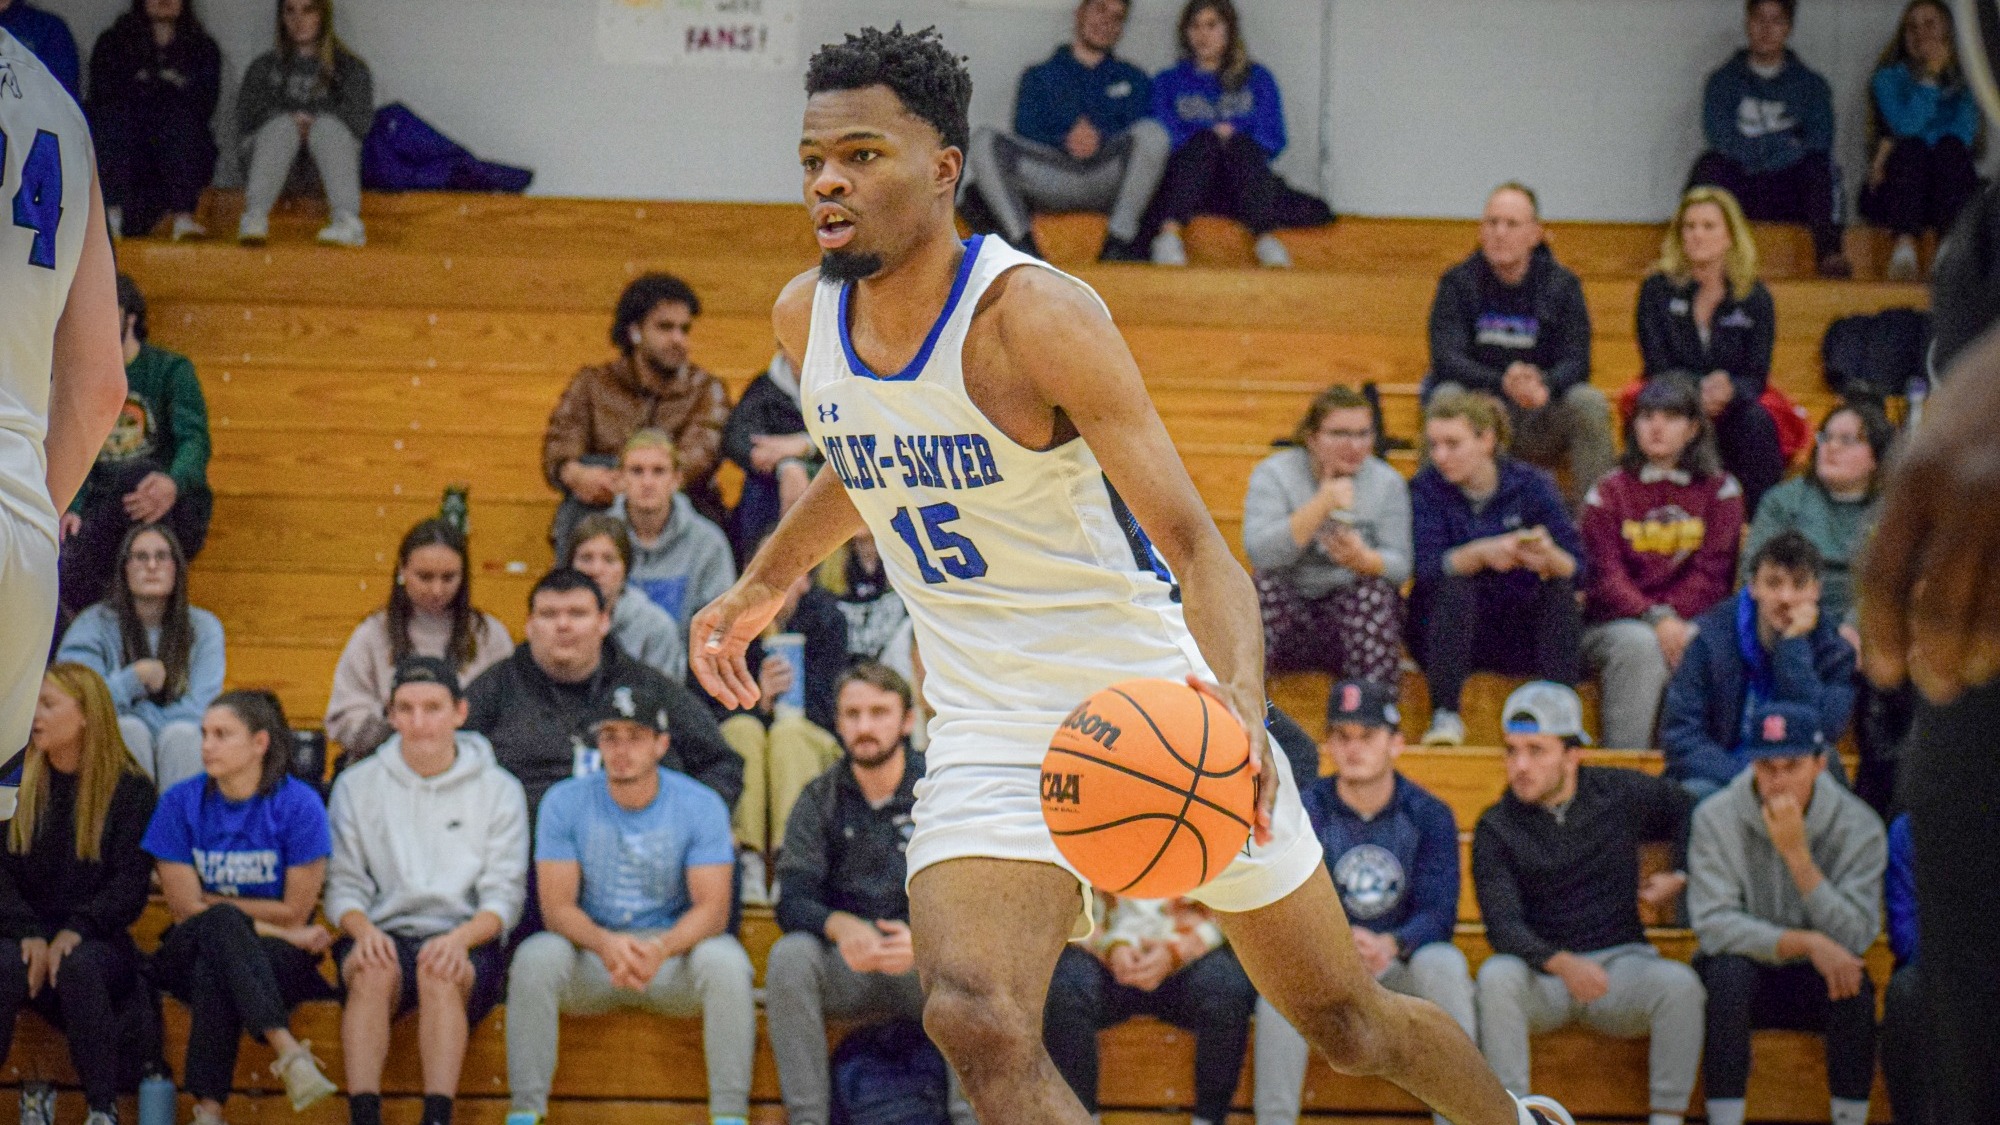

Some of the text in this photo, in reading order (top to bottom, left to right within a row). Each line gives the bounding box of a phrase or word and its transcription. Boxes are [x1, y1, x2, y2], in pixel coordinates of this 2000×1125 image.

[0, 126, 64, 270] 4
[890, 502, 988, 584] 15
[1040, 772, 1080, 805] CAA
